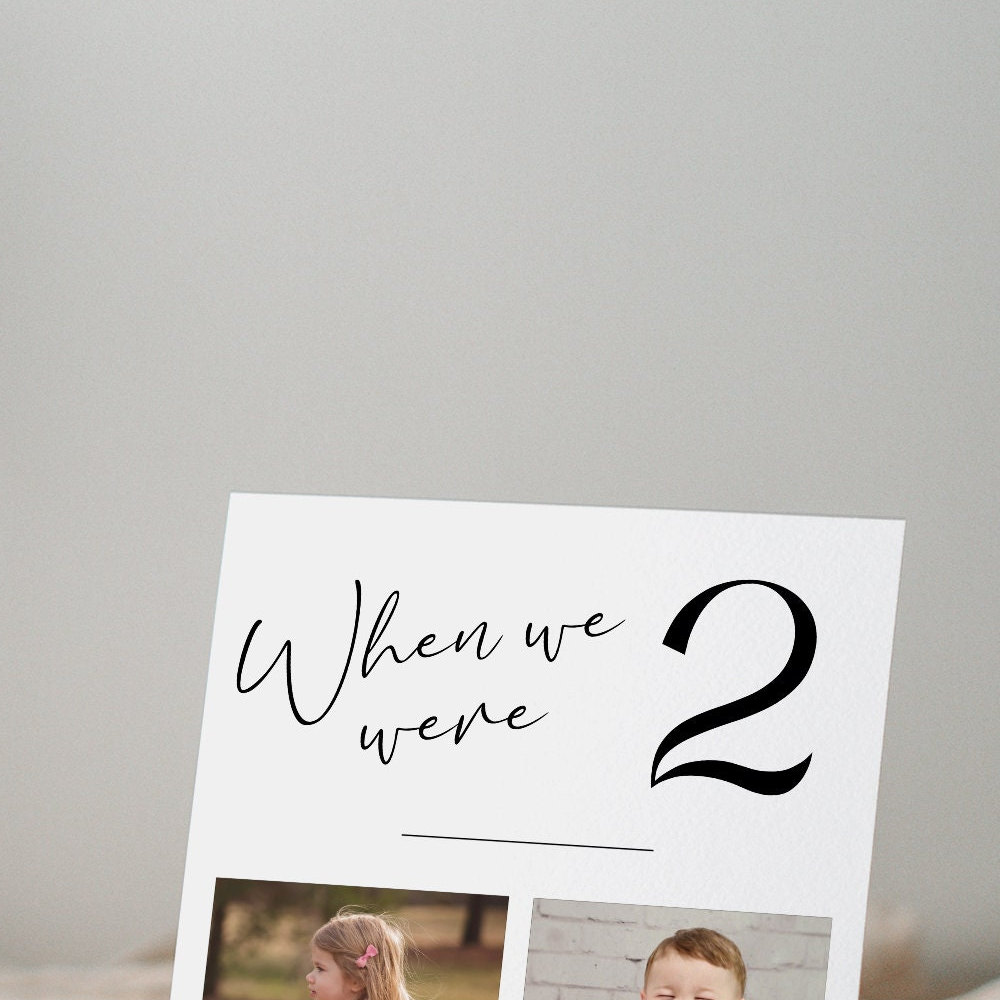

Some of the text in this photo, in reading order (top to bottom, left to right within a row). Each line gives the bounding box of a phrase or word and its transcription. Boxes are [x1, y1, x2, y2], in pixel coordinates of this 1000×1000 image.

[237, 580, 626, 726] When we
[651, 580, 818, 796] 2
[359, 702, 549, 766] were
